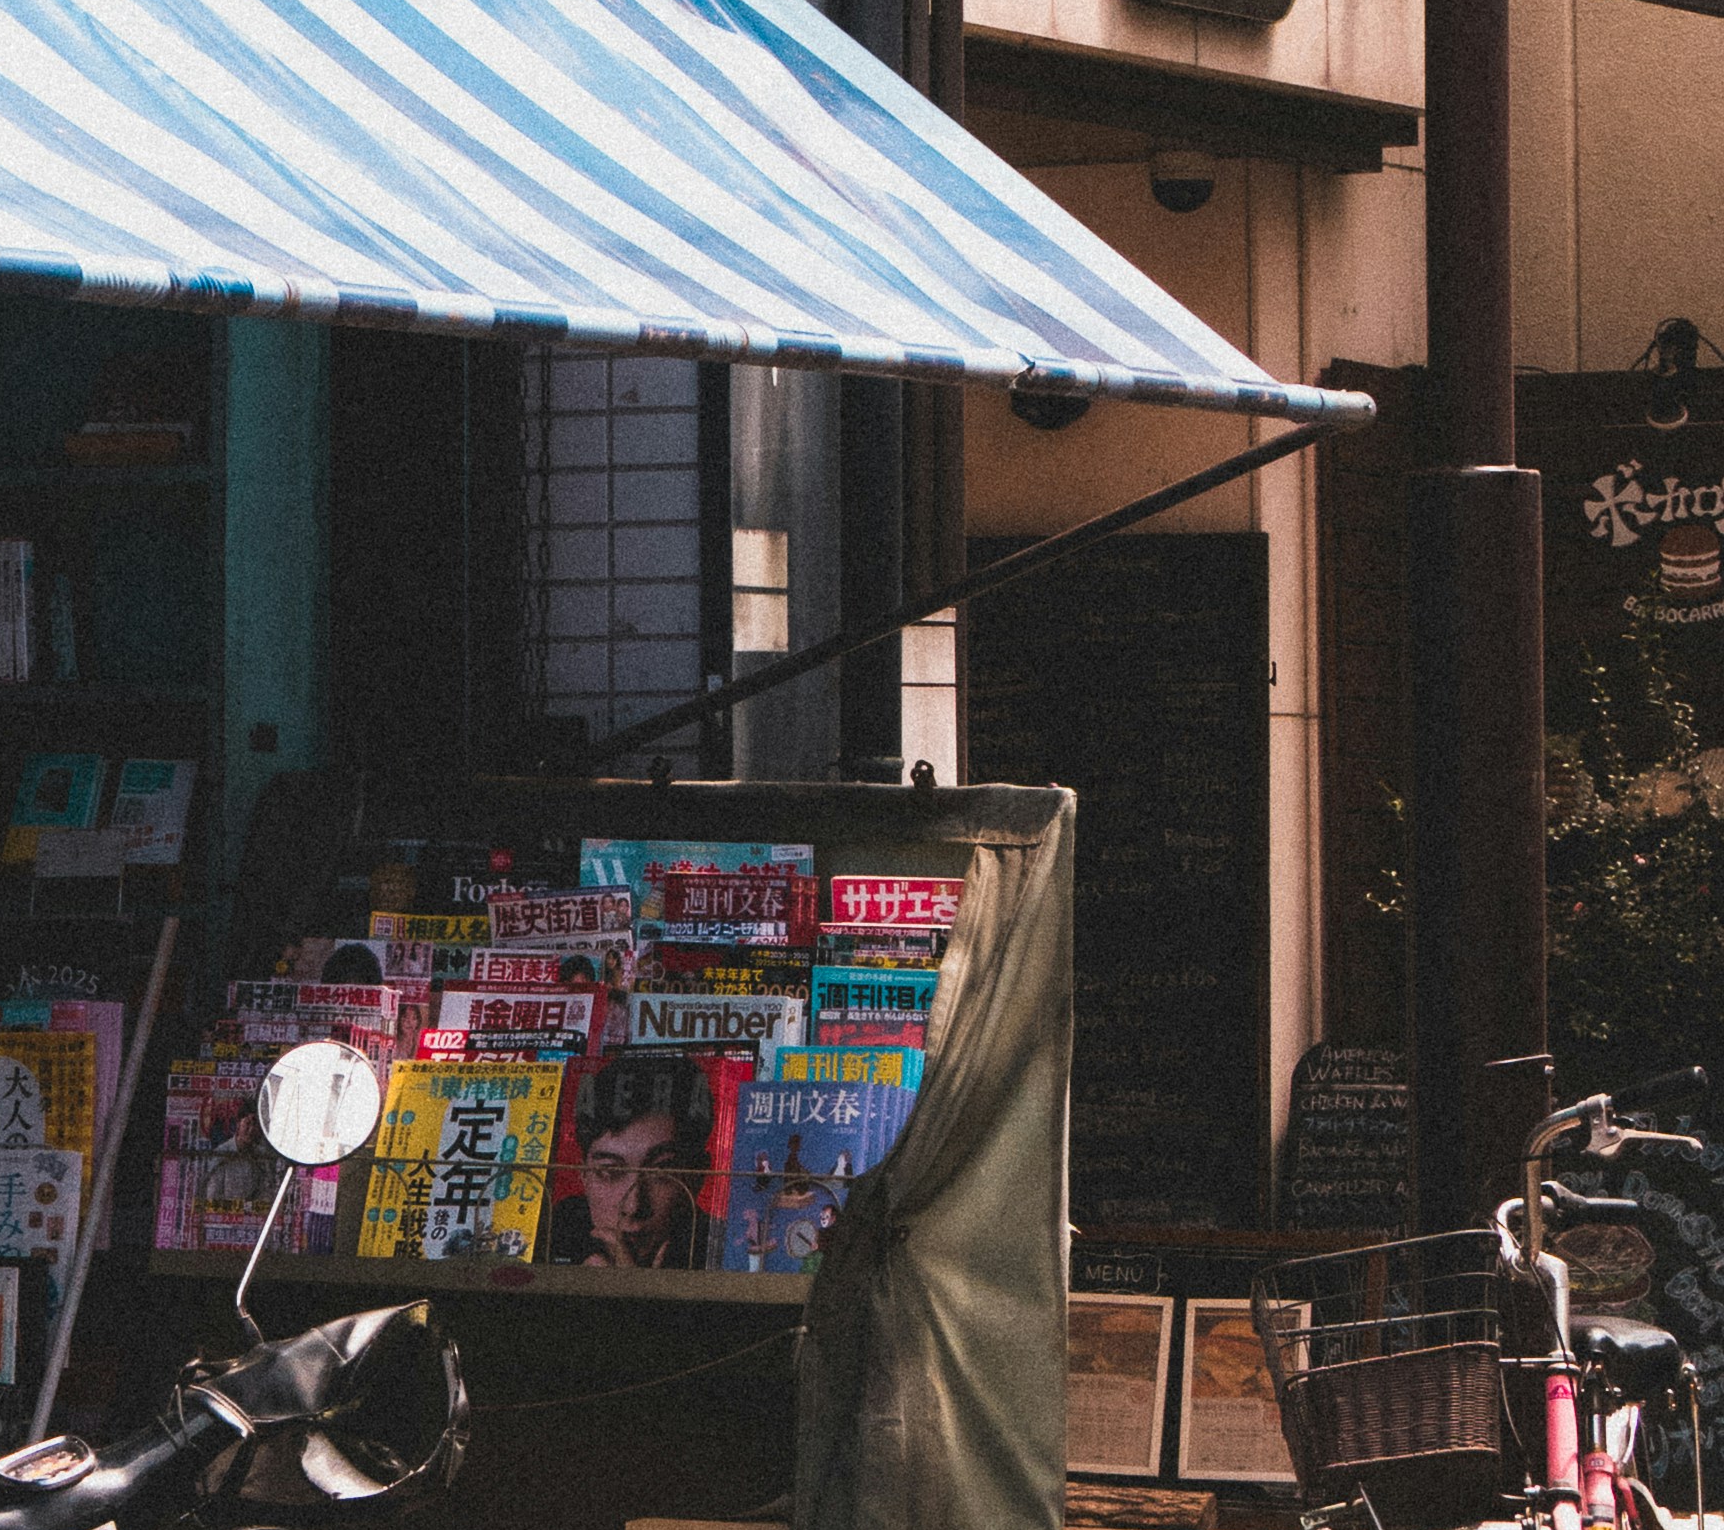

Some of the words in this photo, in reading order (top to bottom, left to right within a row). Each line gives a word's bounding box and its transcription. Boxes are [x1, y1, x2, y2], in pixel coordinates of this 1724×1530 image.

[1583, 458, 1724, 548] ボカロ
[494, 898, 599, 939] 歴史街道
[682, 886, 785, 917] 週刊文春
[47, 964, 100, 995] 2025
[637, 999, 782, 1040] Number
[781, 1050, 905, 1085] 週刊新潮
[743, 1089, 861, 1126] 週刊文春
[1084, 1264, 1145, 1283] MENU
